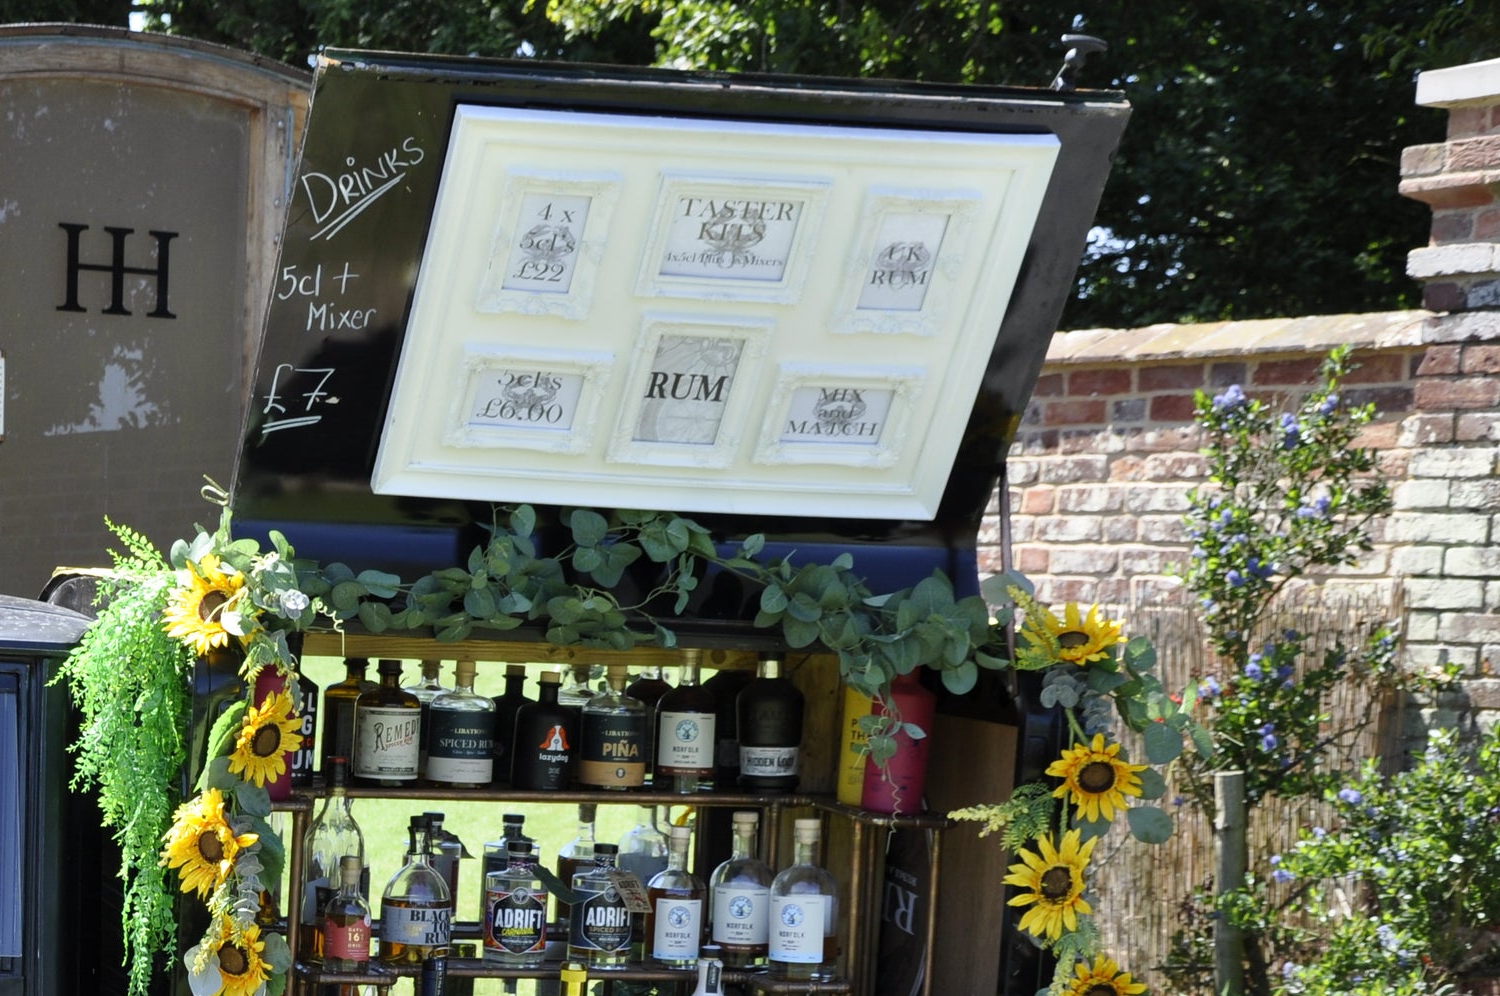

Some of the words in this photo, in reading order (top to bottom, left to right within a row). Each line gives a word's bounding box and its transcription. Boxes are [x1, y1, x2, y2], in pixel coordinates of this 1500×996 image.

[679, 197, 795, 222] TASTER
[697, 220, 765, 242] KITS
[886, 246, 924, 262] UK
[55, 221, 180, 320] HH
[512, 260, 566, 283] £22
[869, 269, 929, 285] RUM
[277, 264, 322, 301] 5cl
[305, 301, 377, 332] Mixer
[262, 363, 336, 415] £7
[643, 371, 730, 403] RUM
[820, 387, 868, 402] MIX
[475, 397, 564, 424] £6.00
[817, 403, 856, 419] and
[784, 419, 880, 437] MATCH
[439, 738, 477, 749] SPICED
[602, 739, 639, 758] PIÑA
[494, 908, 543, 930] ADRIFT
[726, 922, 754, 930] NORFOLK
